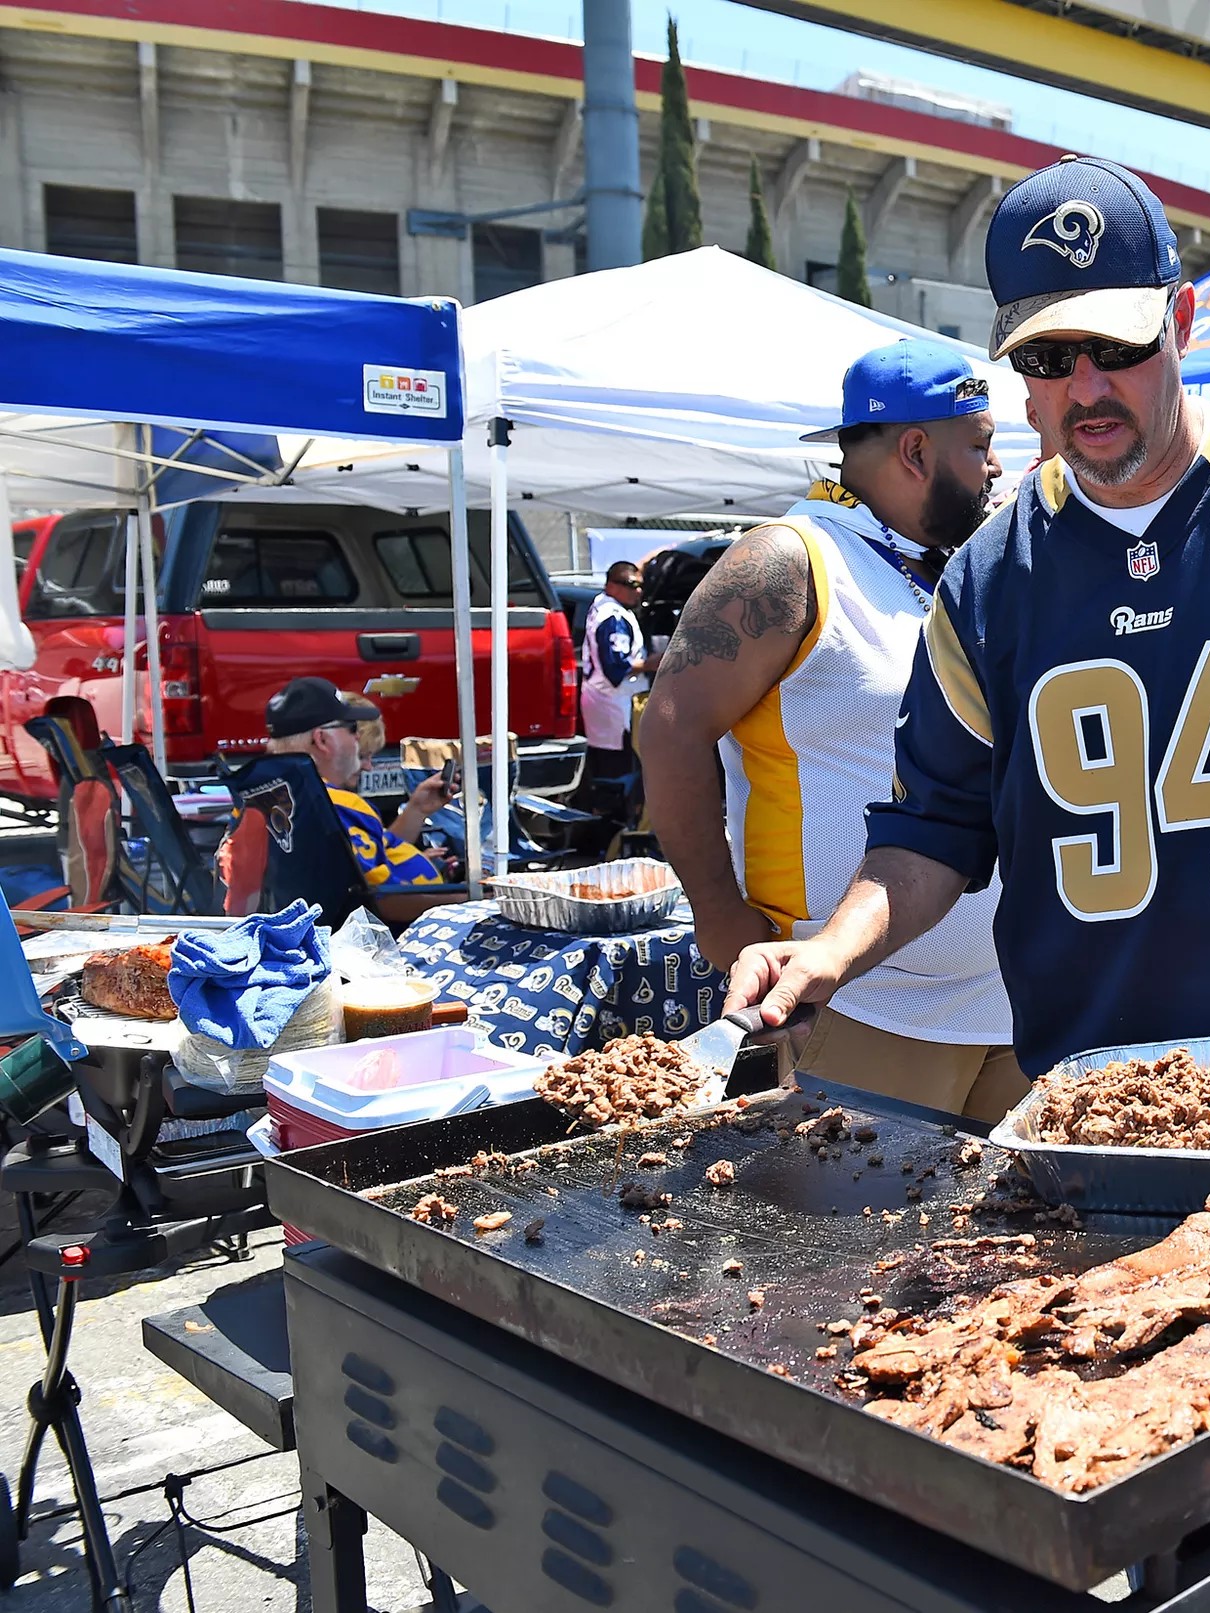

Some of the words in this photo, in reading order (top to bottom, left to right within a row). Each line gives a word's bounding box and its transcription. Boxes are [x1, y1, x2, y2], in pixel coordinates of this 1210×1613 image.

[372, 390, 402, 401] Instant
[405, 393, 434, 404] Shelter
[1132, 556, 1156, 574] NFL
[1110, 606, 1174, 636] Rams
[505, 999, 533, 1018] Rams
[465, 1015, 491, 1034] Rams
